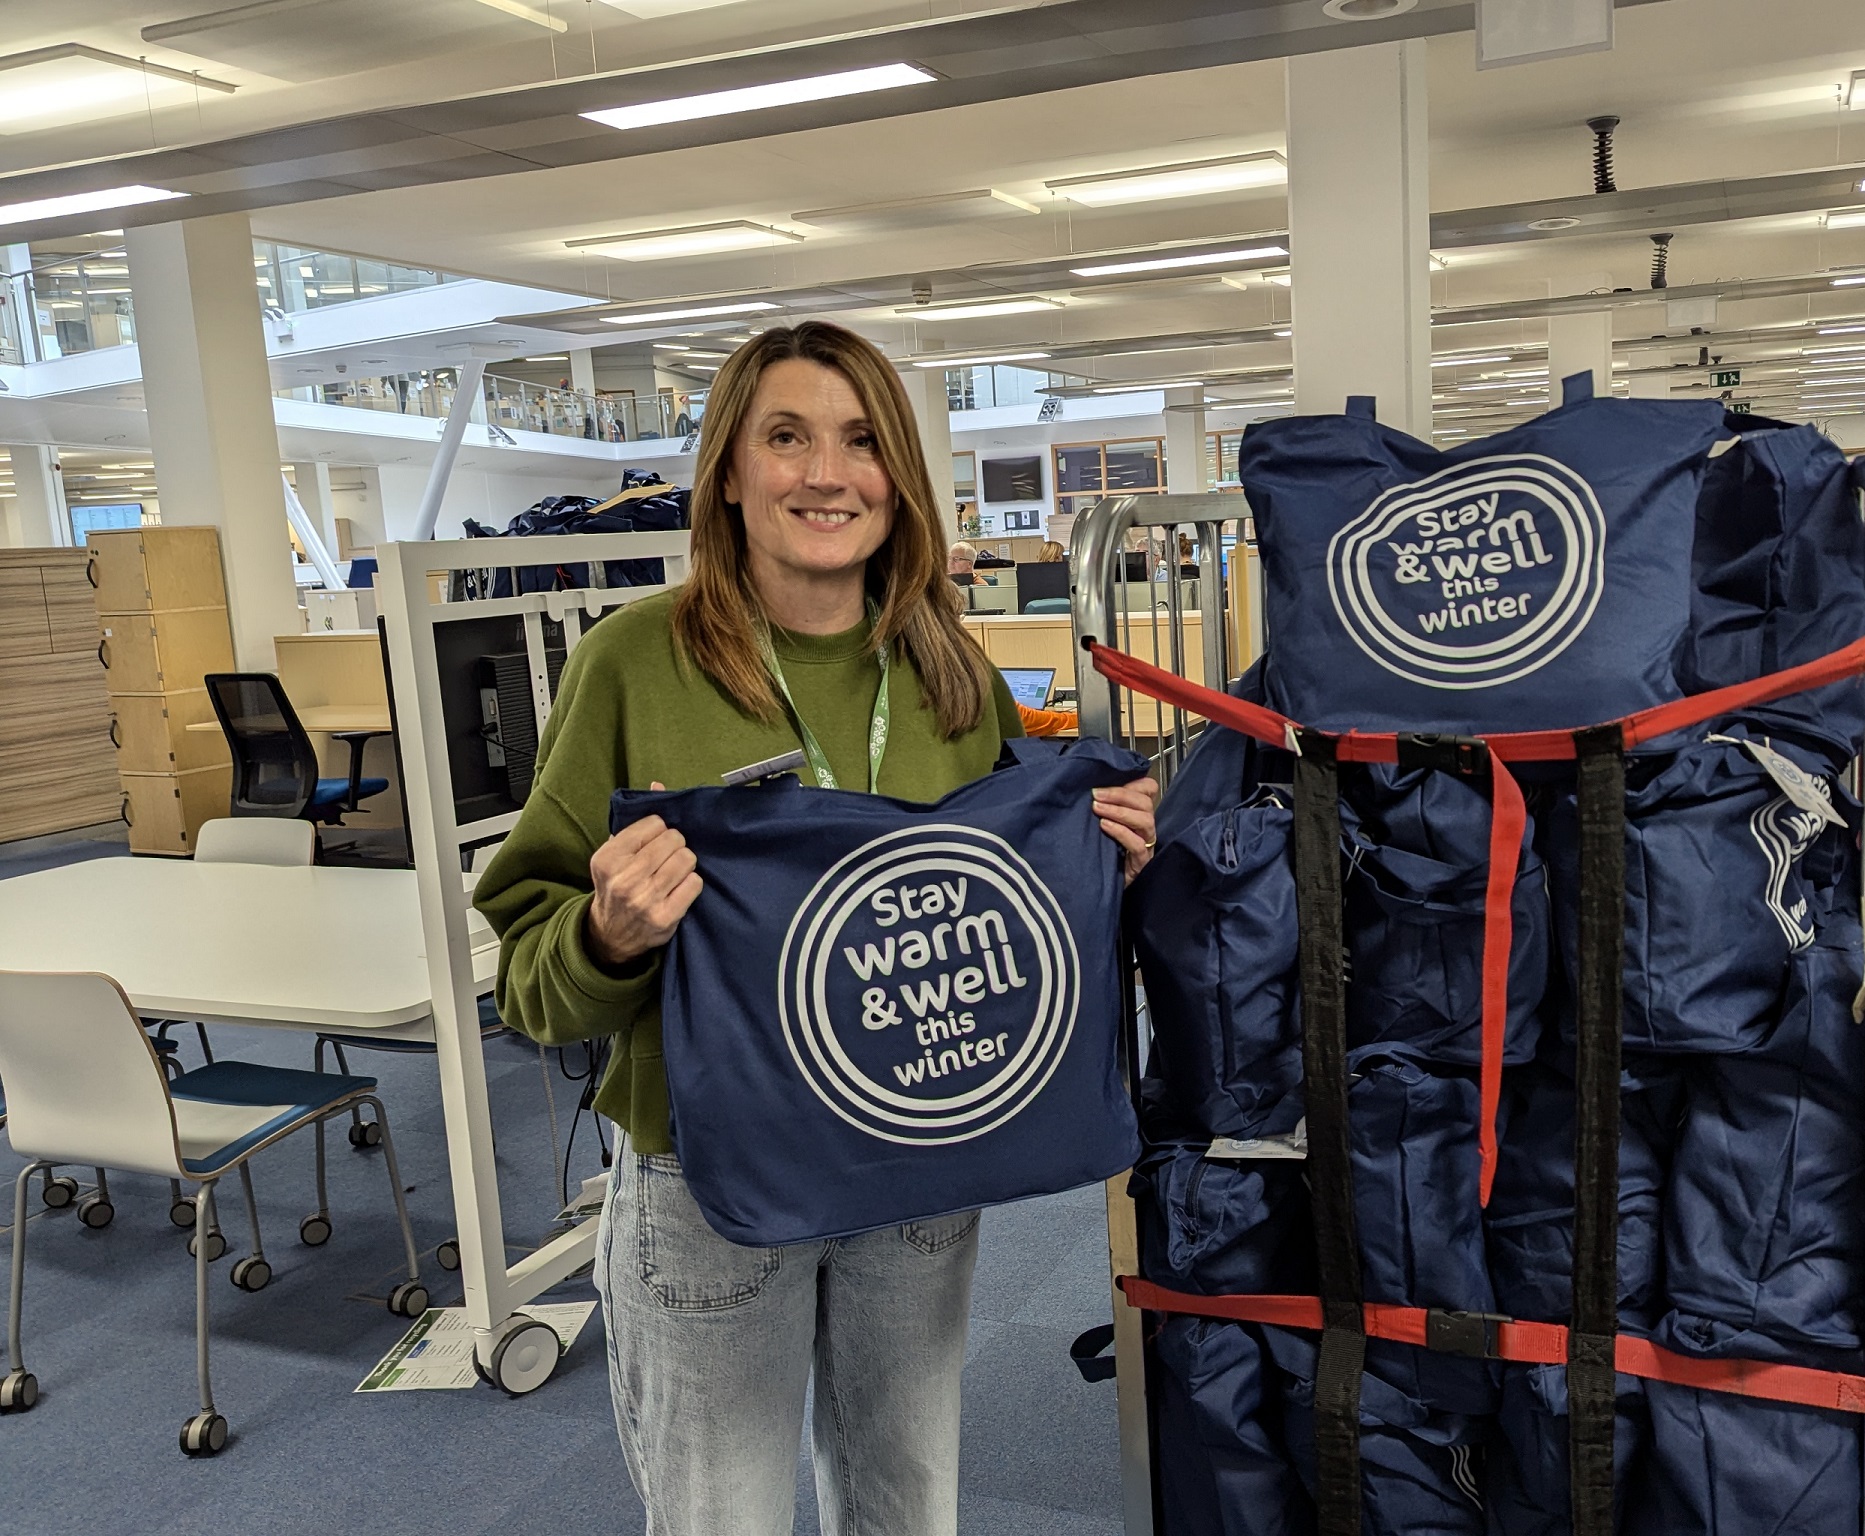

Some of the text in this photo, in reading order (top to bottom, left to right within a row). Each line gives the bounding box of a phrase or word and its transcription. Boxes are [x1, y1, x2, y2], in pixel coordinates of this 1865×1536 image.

[1387, 509, 1536, 555] warm
[1416, 492, 1499, 537] Stay
[1394, 532, 1553, 584] & well
[1441, 576, 1500, 599] this
[1418, 593, 1532, 634] winter
[871, 876, 967, 927] Stay
[843, 909, 1009, 981] warm
[861, 944, 1027, 1031] & well
[915, 1010, 976, 1046] this
[892, 1032, 1009, 1087] winter
[373, 1361, 394, 1377] Thank
[389, 1351, 402, 1361] you
[405, 1323, 428, 1344] recycling
